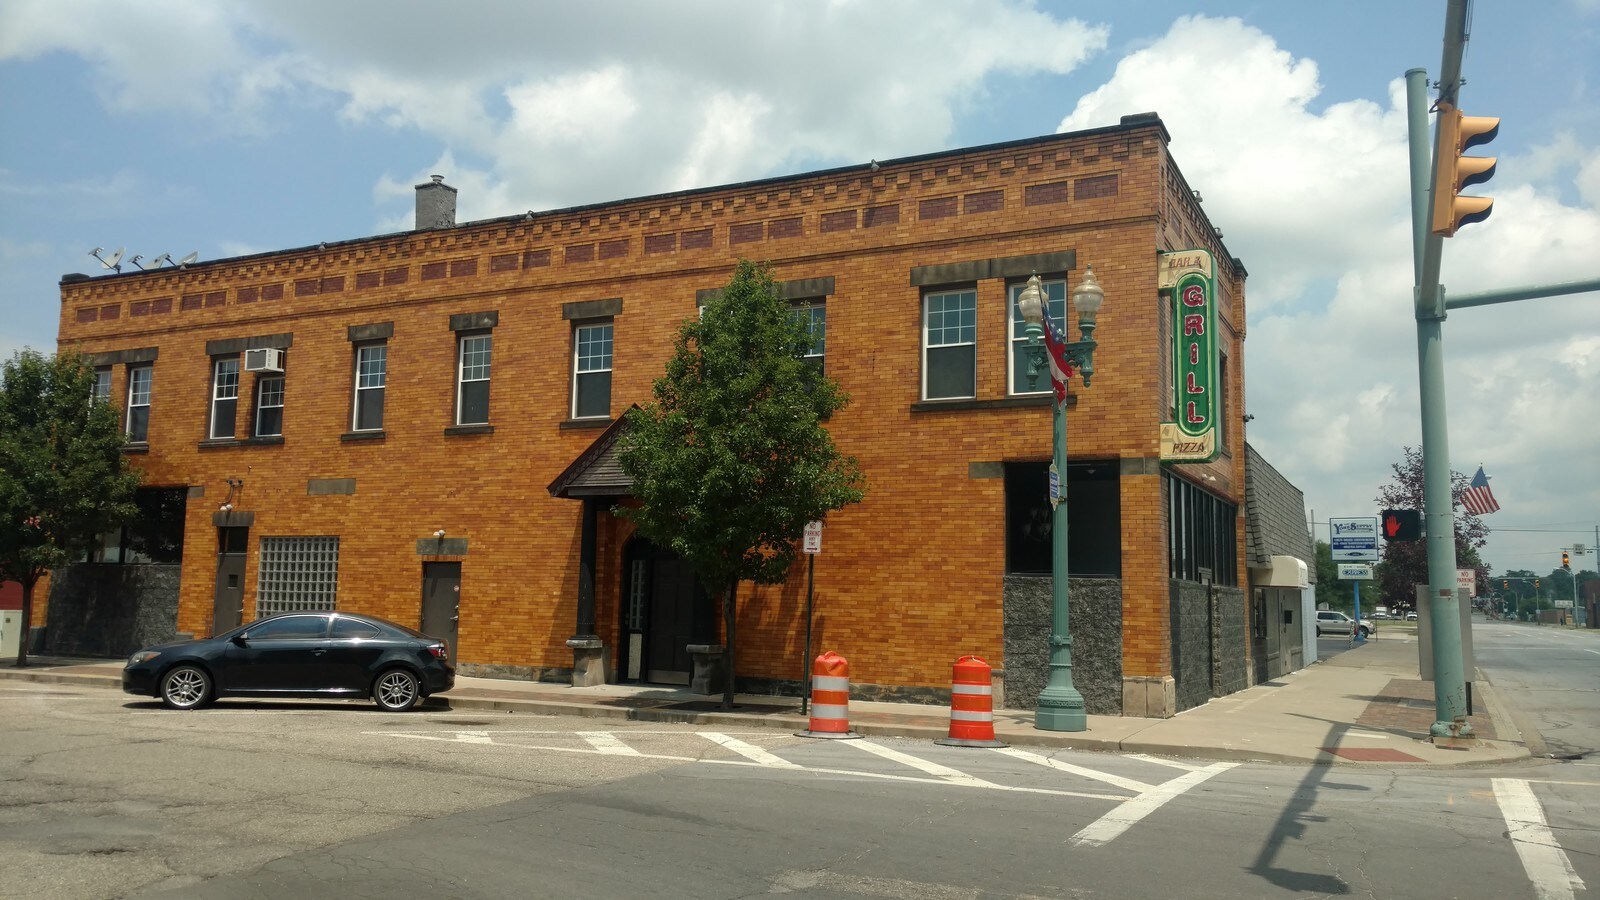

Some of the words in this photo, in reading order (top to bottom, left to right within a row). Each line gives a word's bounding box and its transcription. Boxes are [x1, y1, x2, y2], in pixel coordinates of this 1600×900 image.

[1168, 256, 1191, 269] BAR
[1182, 285, 1206, 423] GRILL
[1172, 442, 1205, 453] PIZZA
[809, 522, 817, 530] NO
